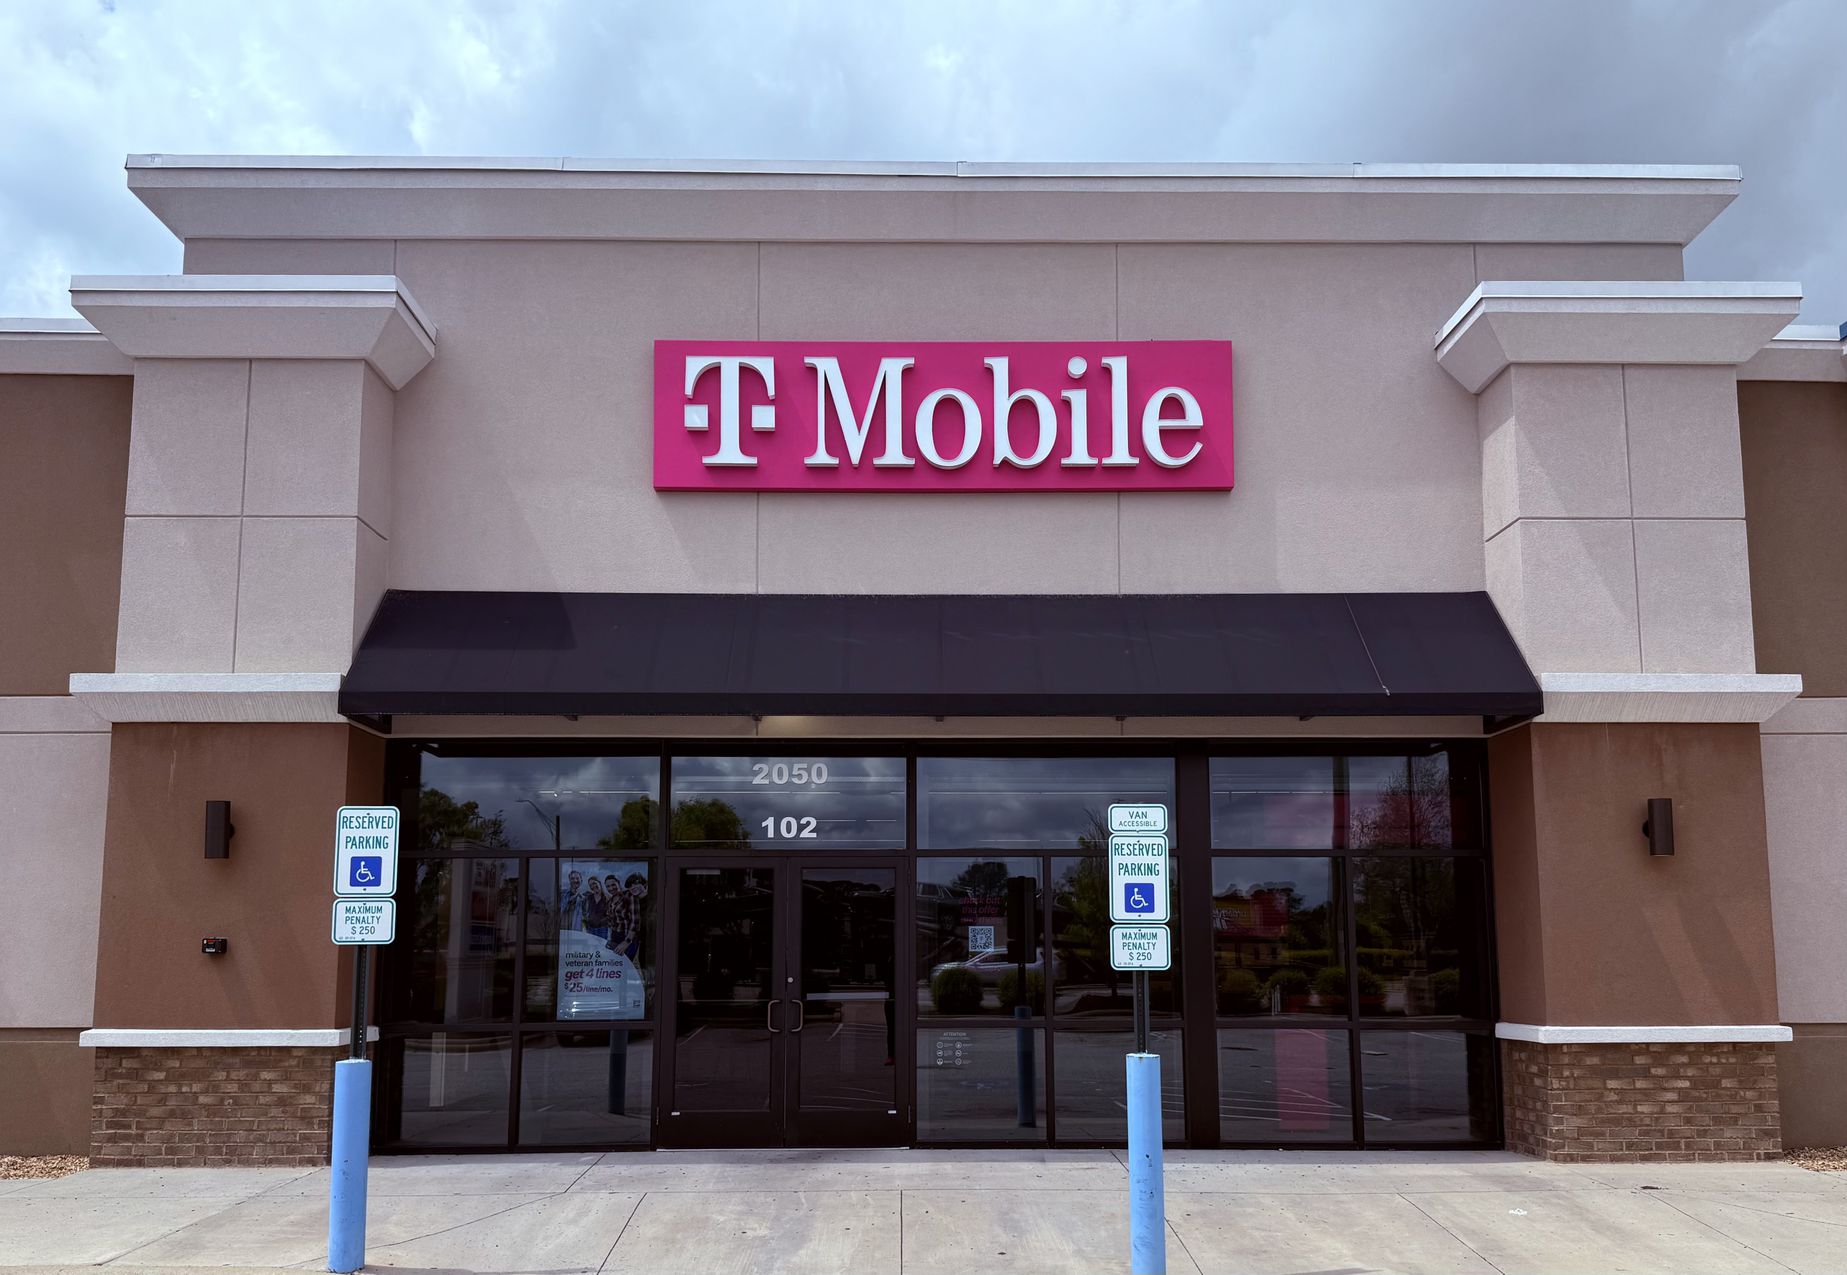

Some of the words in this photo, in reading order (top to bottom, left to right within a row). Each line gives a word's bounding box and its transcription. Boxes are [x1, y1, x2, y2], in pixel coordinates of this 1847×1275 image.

[803, 355, 1204, 470] Mobile
[751, 763, 829, 785] 2050
[1128, 811, 1148, 819] VAN
[342, 816, 394, 830] RESERVED
[761, 816, 818, 838] 102
[345, 836, 389, 850] PARKING
[1114, 843, 1164, 857] RESERVED
[1118, 863, 1160, 877] PARKING
[344, 905, 383, 914] MAXIMUM
[344, 916, 381, 925] PENALTY
[1121, 932, 1158, 941] MAXIMUM
[1122, 942, 1157, 951] PENALTY
[565, 951, 594, 960] military
[595, 951, 601, 959] &
[565, 959, 593, 967] veteran
[594, 959, 624, 967] families
[564, 969, 585, 982] get
[586, 968, 594, 979] 4
[596, 968, 622, 979] lines
